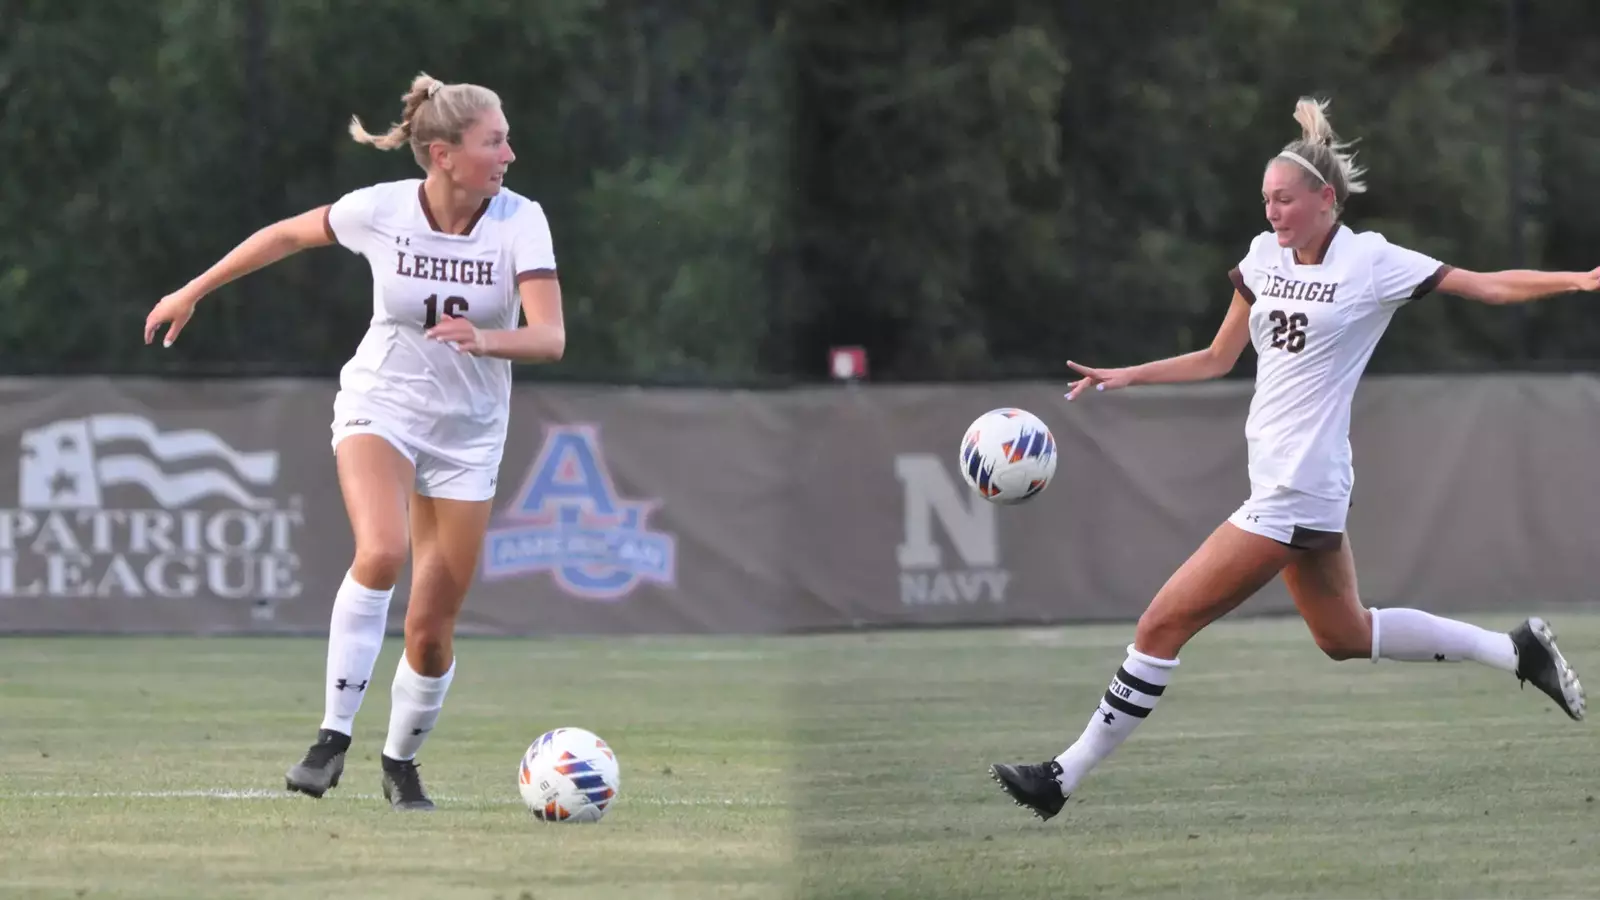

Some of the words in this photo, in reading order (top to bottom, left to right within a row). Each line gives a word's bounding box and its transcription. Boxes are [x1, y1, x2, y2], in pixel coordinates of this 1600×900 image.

[396, 251, 494, 285] LEHIGH
[1261, 274, 1338, 303] LEHIGH
[423, 293, 469, 331] 16
[1269, 309, 1309, 353] 26
[0, 509, 303, 552] PATRIOT
[895, 454, 999, 567] N
[0, 552, 303, 598] LEAGUE
[900, 570, 1011, 605] NAVY
